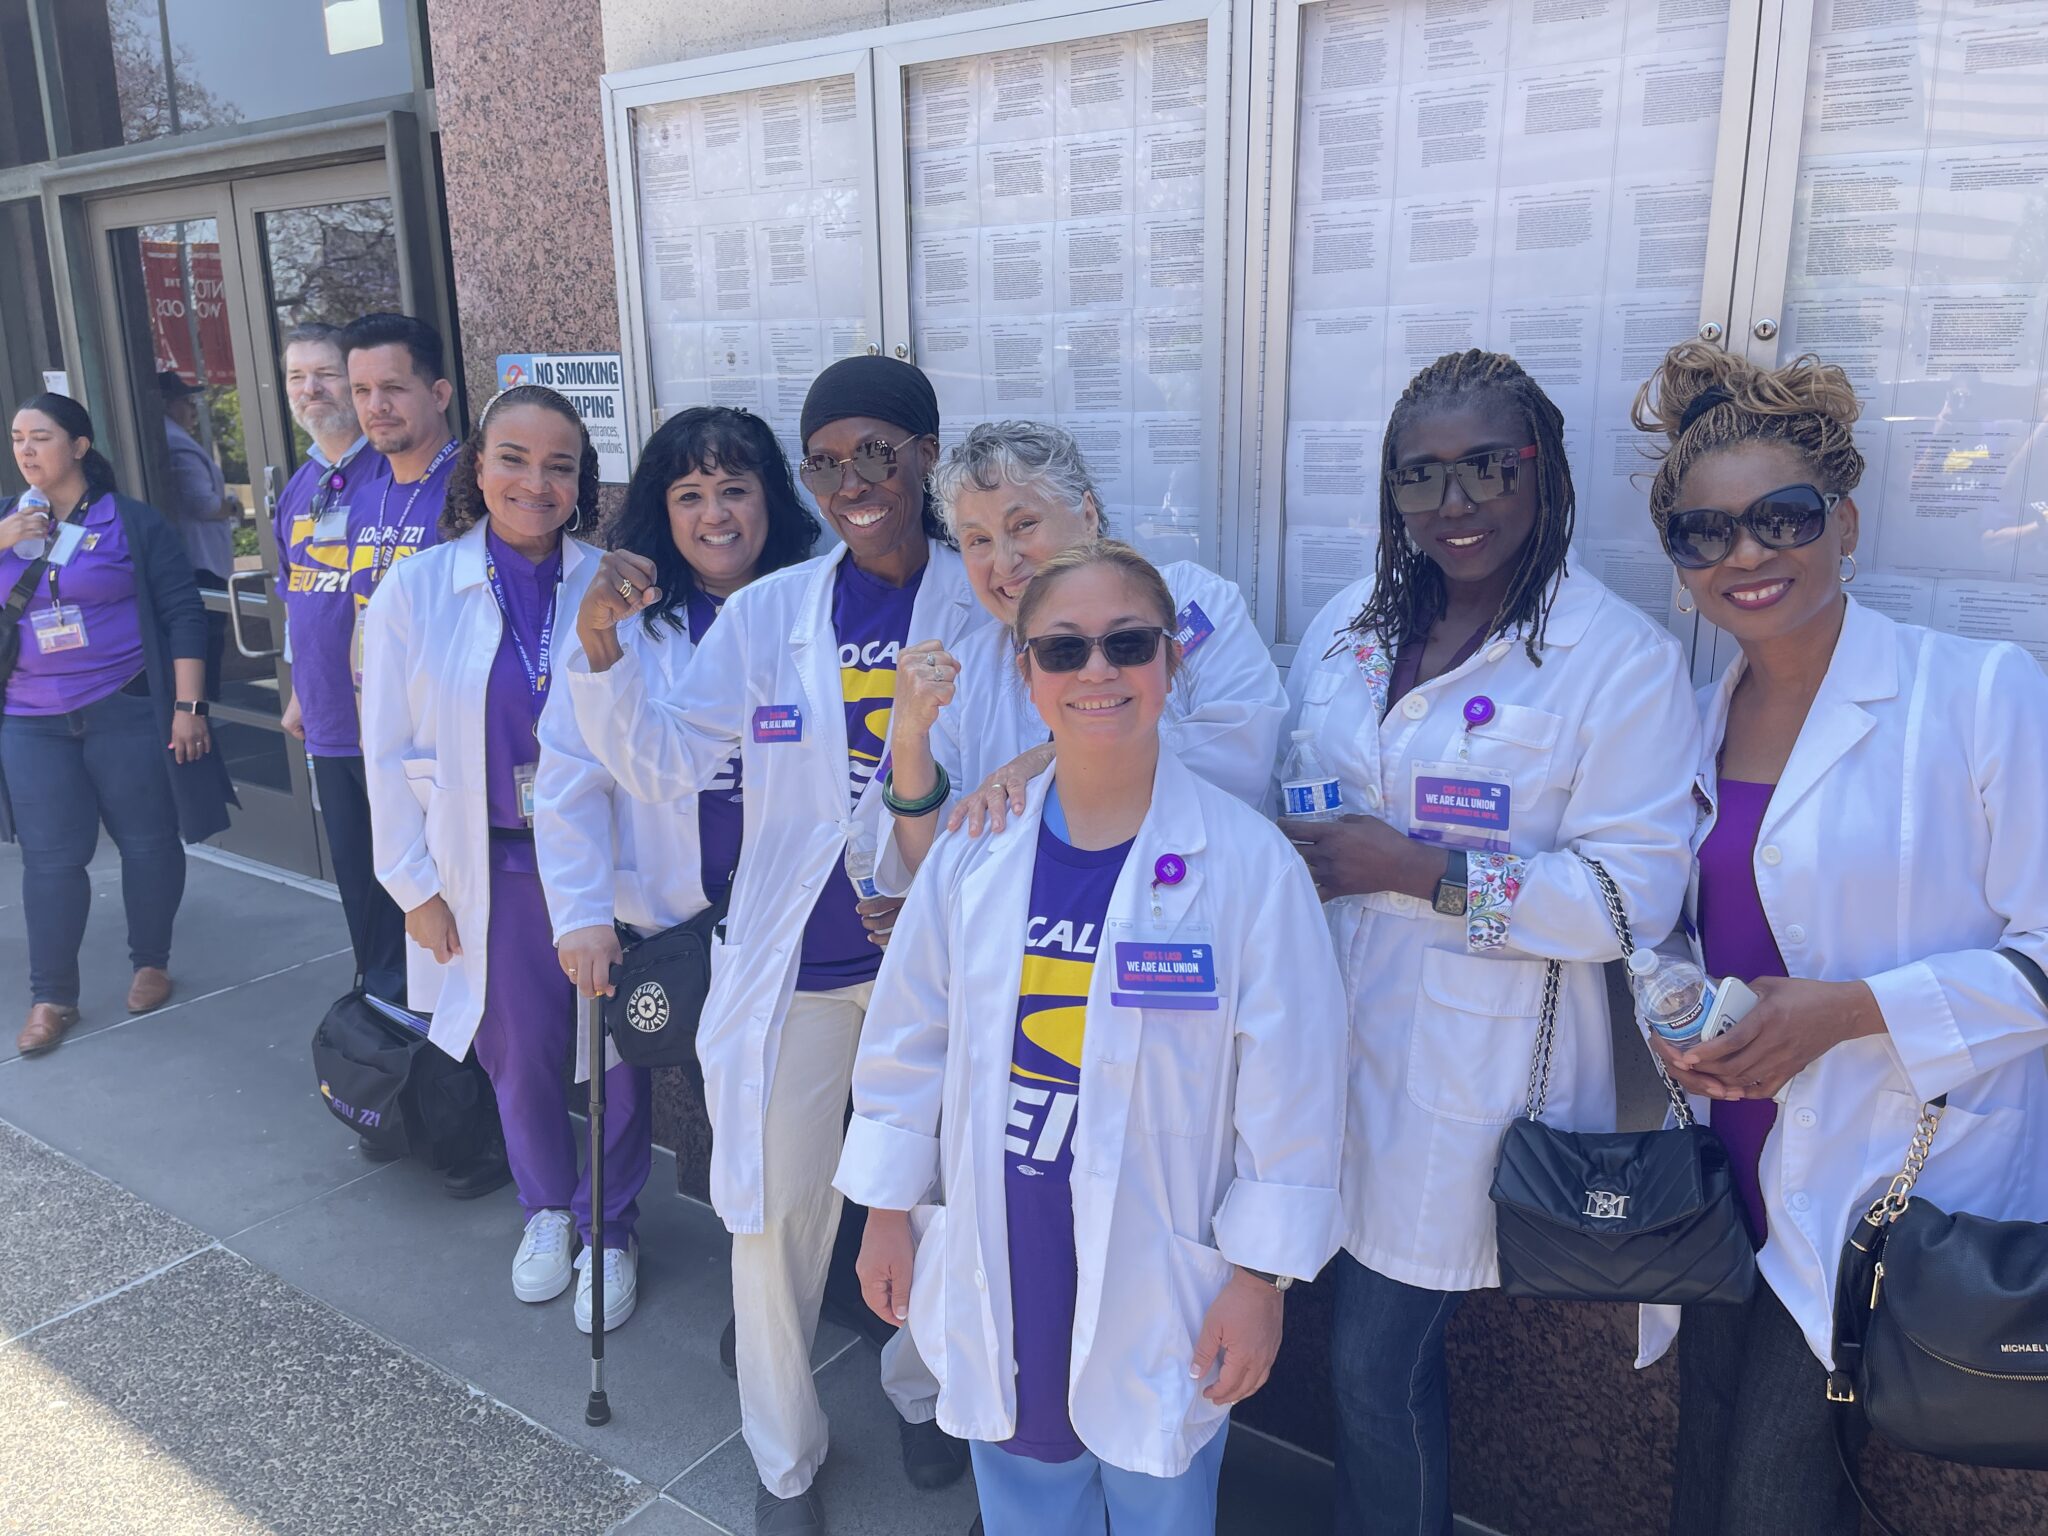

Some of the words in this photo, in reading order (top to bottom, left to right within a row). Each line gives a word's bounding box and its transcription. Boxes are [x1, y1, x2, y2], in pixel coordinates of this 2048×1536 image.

[535, 361, 553, 385] NO
[556, 361, 619, 385] SMOKING
[597, 440, 624, 454] windows.
[428, 454, 444, 473] SEIU
[441, 443, 454, 456] 721
[391, 529, 400, 545] 721
[401, 526, 425, 543] 721
[540, 629, 550, 646] 721
[538, 648, 549, 674] SEIU
[1425, 793, 1438, 804] WE
[1439, 795, 1455, 806] ARE
[1456, 797, 1470, 808] ALL
[1471, 798, 1496, 811] UNION
[1025, 916, 1096, 954] CAL
[1126, 960, 1140, 972] WE
[1141, 961, 1157, 973] ARE
[1158, 961, 1173, 973] ALL
[1173, 962, 1199, 974] UNION
[630, 984, 661, 1006] KIPLING
[358, 1109, 380, 1127] 721
[2000, 1343, 2044, 1353] MICHAEL
